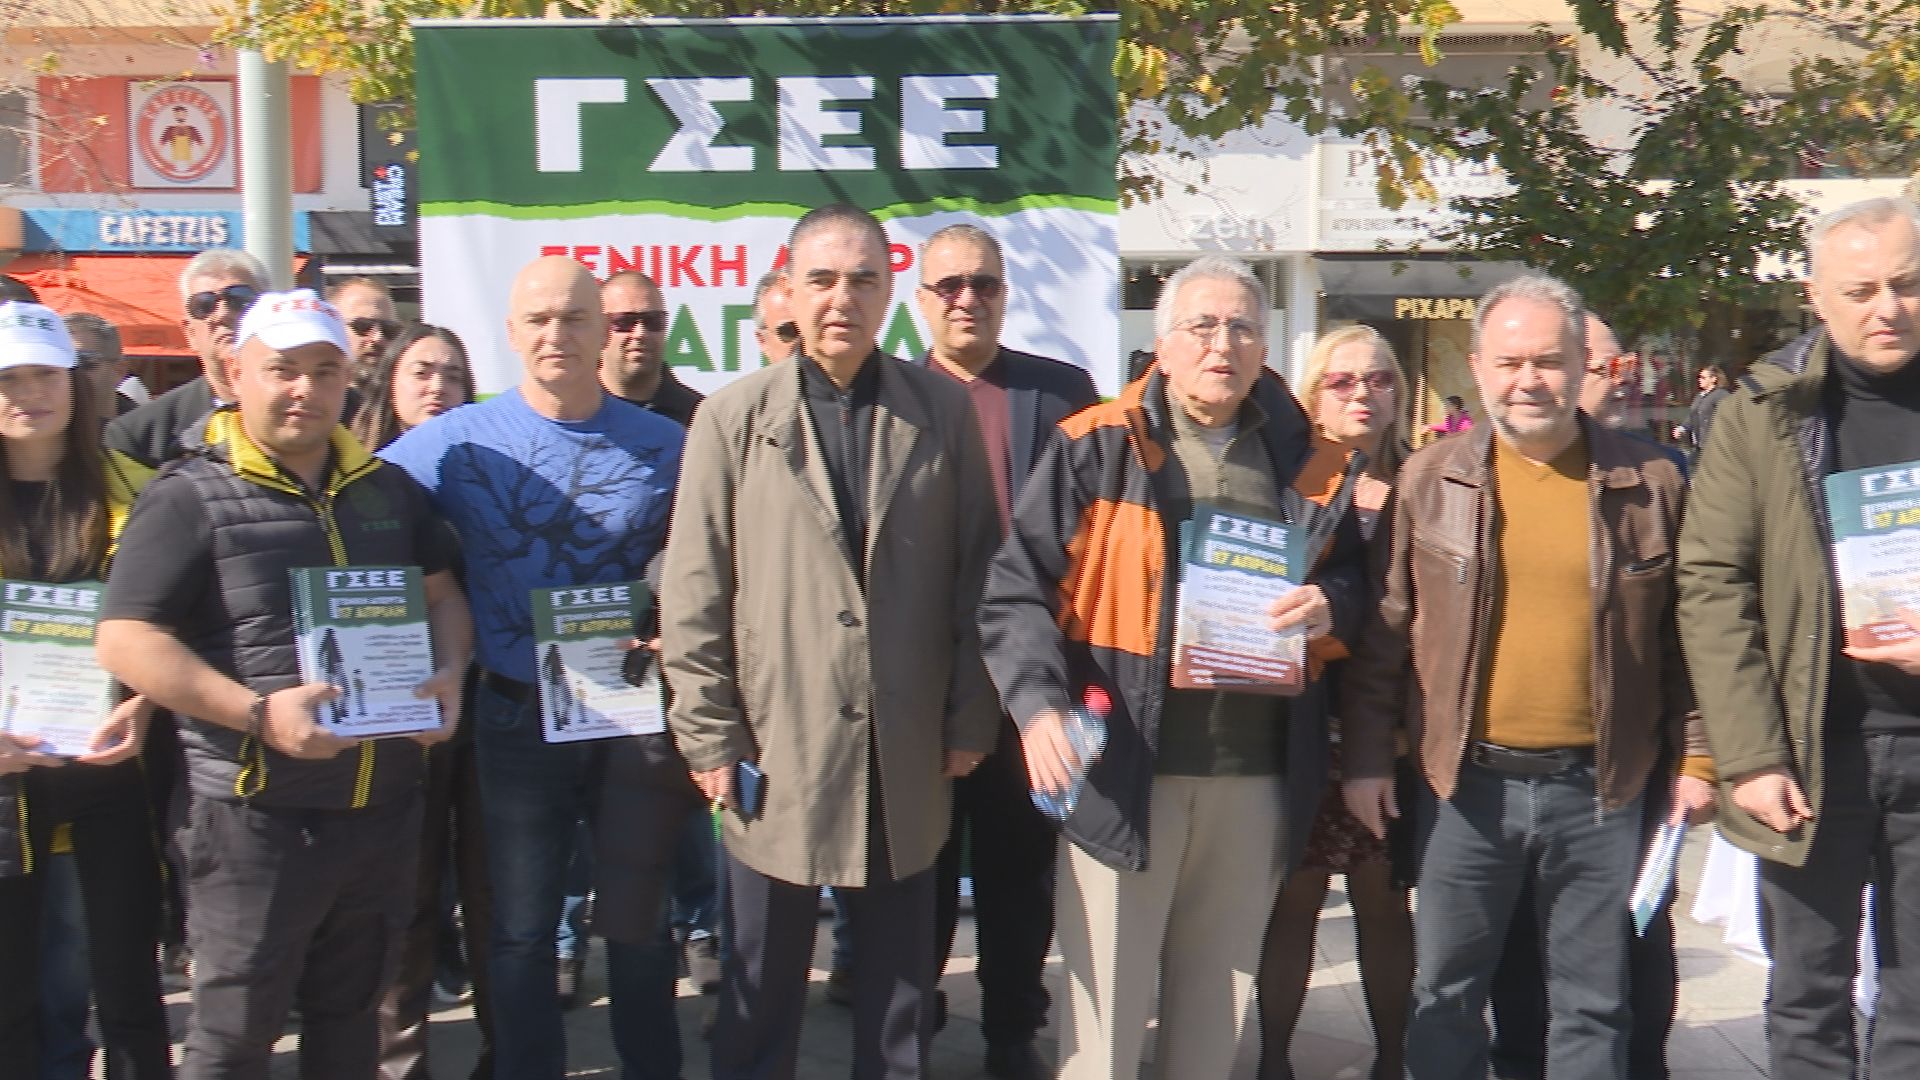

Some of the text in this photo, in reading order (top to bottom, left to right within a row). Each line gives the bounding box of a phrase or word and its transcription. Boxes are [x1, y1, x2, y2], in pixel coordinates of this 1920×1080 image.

[534, 74, 1000, 172] ΓΣΕΕ
[101, 215, 229, 243] CAFETZIS
[1211, 513, 1288, 545] ΓΣΕΕ
[1214, 550, 1230, 565] 17
[1231, 554, 1287, 577] ΑΠΡΙΛΗ
[327, 570, 405, 588] ΓΣΕΕ
[6, 583, 99, 607] ΓΣΕΕ
[551, 586, 630, 606] ΓΣΕΕ
[356, 605, 406, 618] ΑΠΡΙΛΗ
[30, 621, 93, 639] ΑΠΡΙΛΗ
[580, 618, 632, 632] ΑΠΡΙΛΗ
